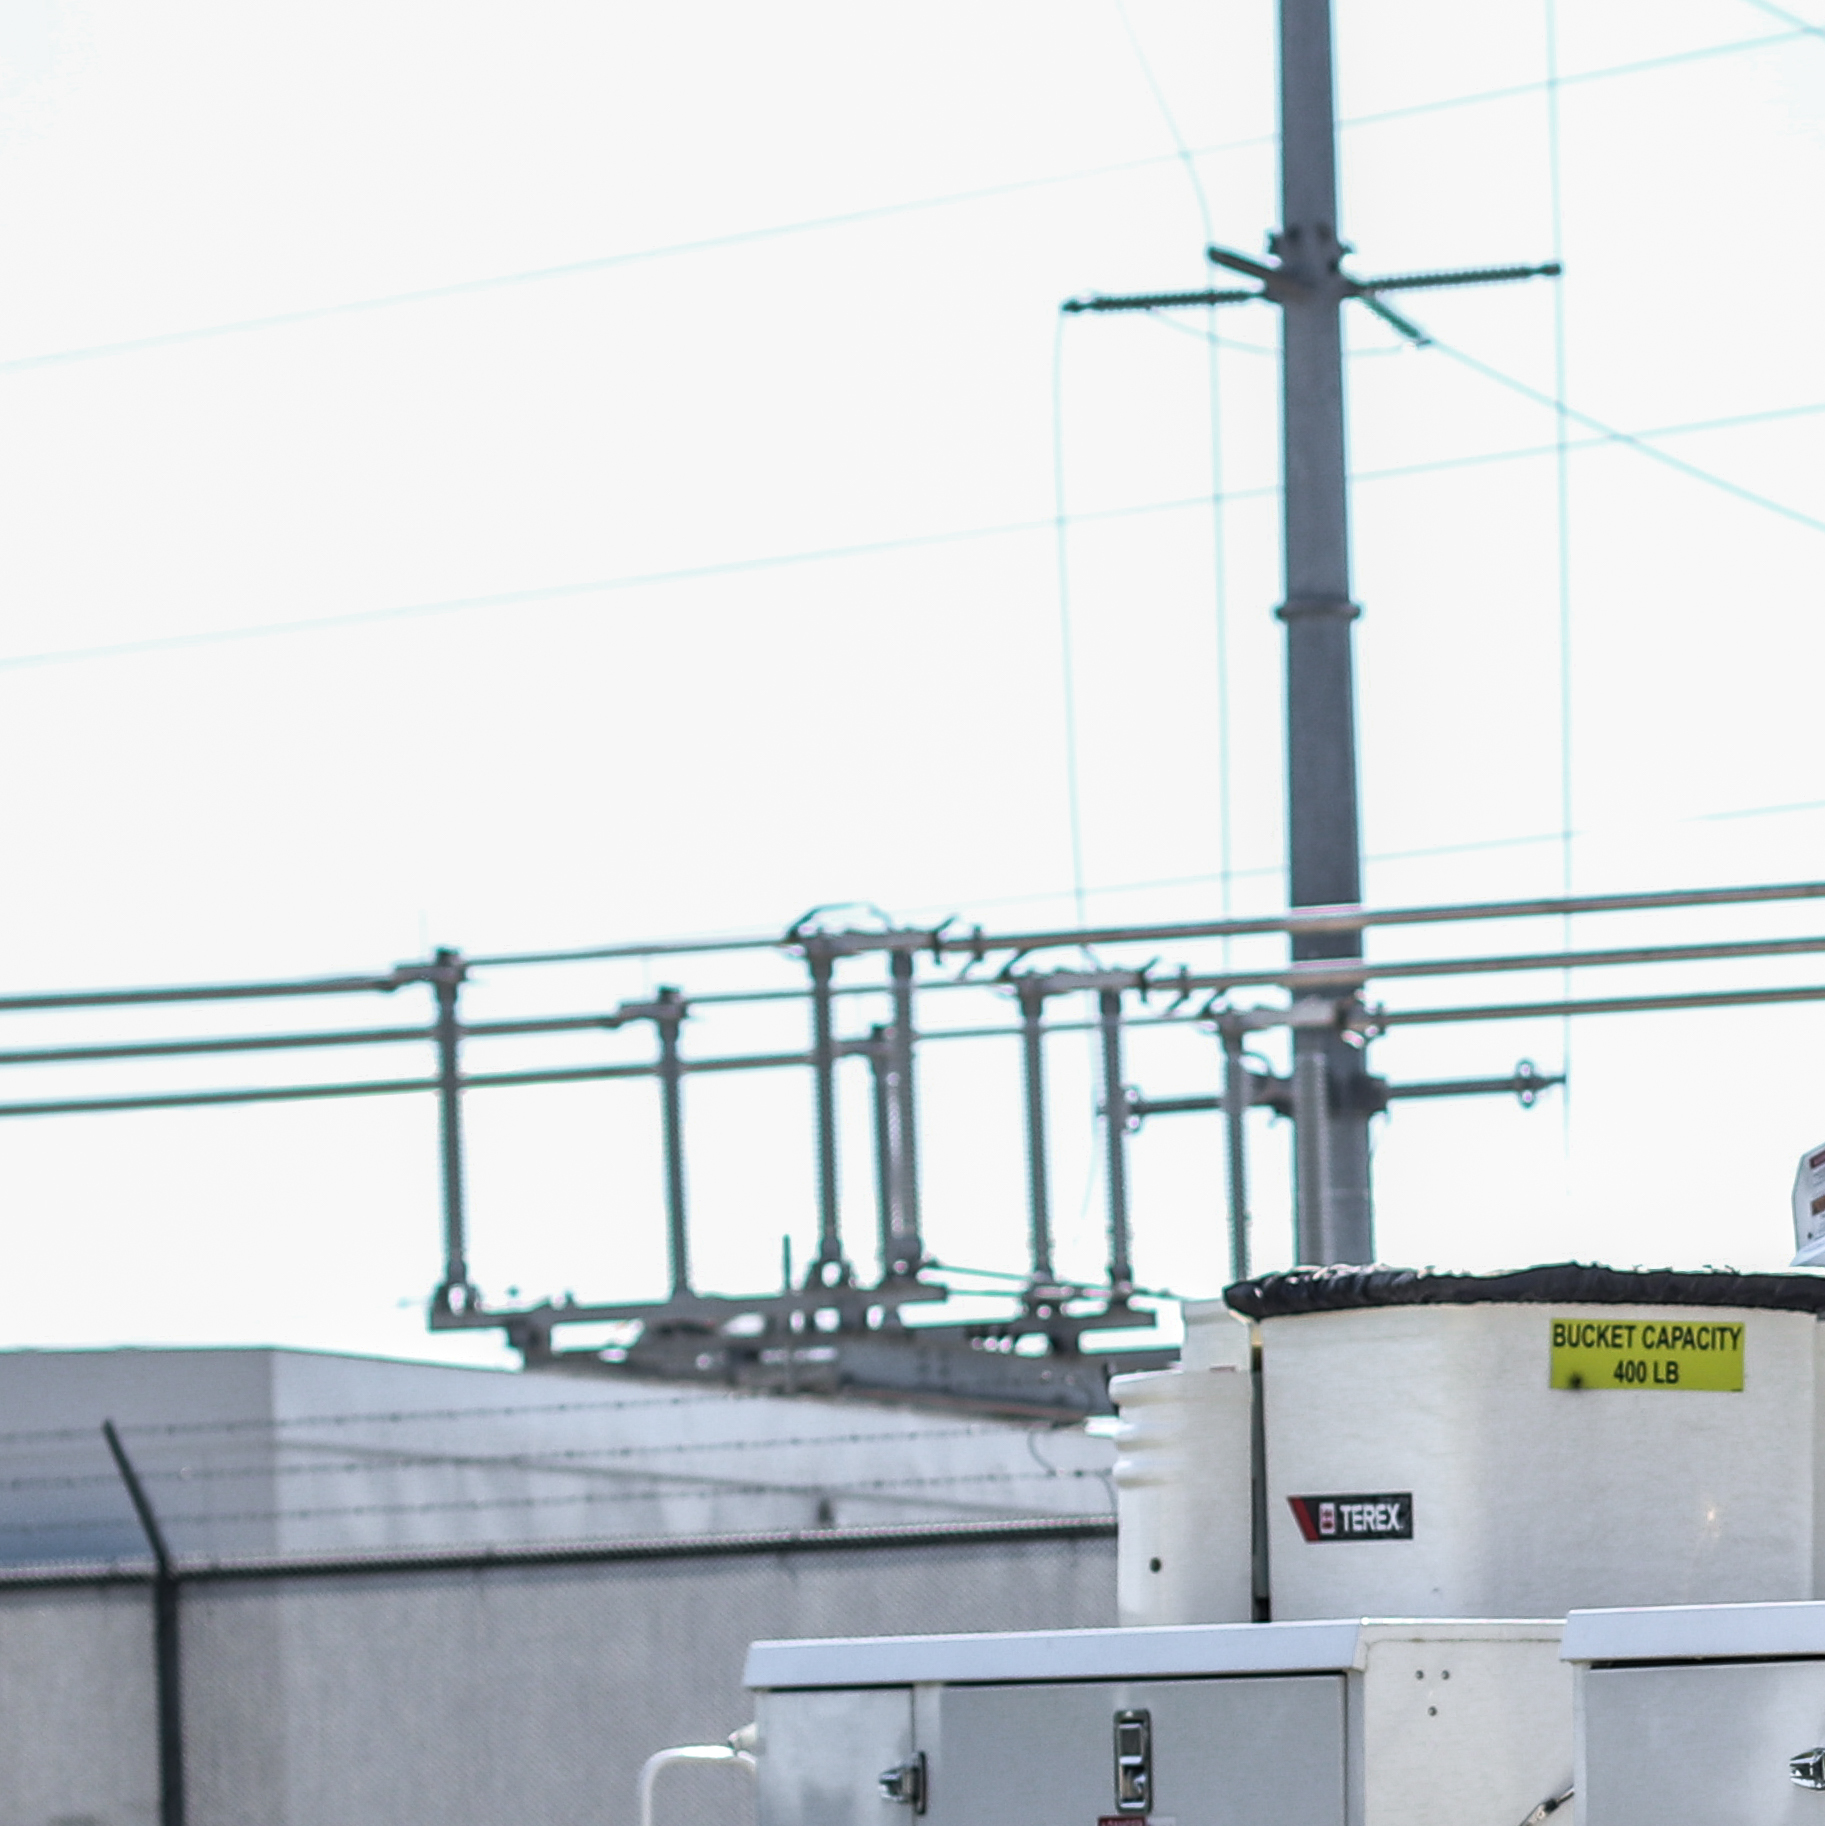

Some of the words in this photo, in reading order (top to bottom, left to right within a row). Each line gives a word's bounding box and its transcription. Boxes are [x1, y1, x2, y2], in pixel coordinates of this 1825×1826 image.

[1553, 1323, 1637, 1349] BUCKET
[1642, 1325, 1742, 1351] CAPACITY
[1613, 1360, 1647, 1384] 400
[1653, 1360, 1679, 1384] LB
[1339, 1503, 1401, 1532] TEREX
